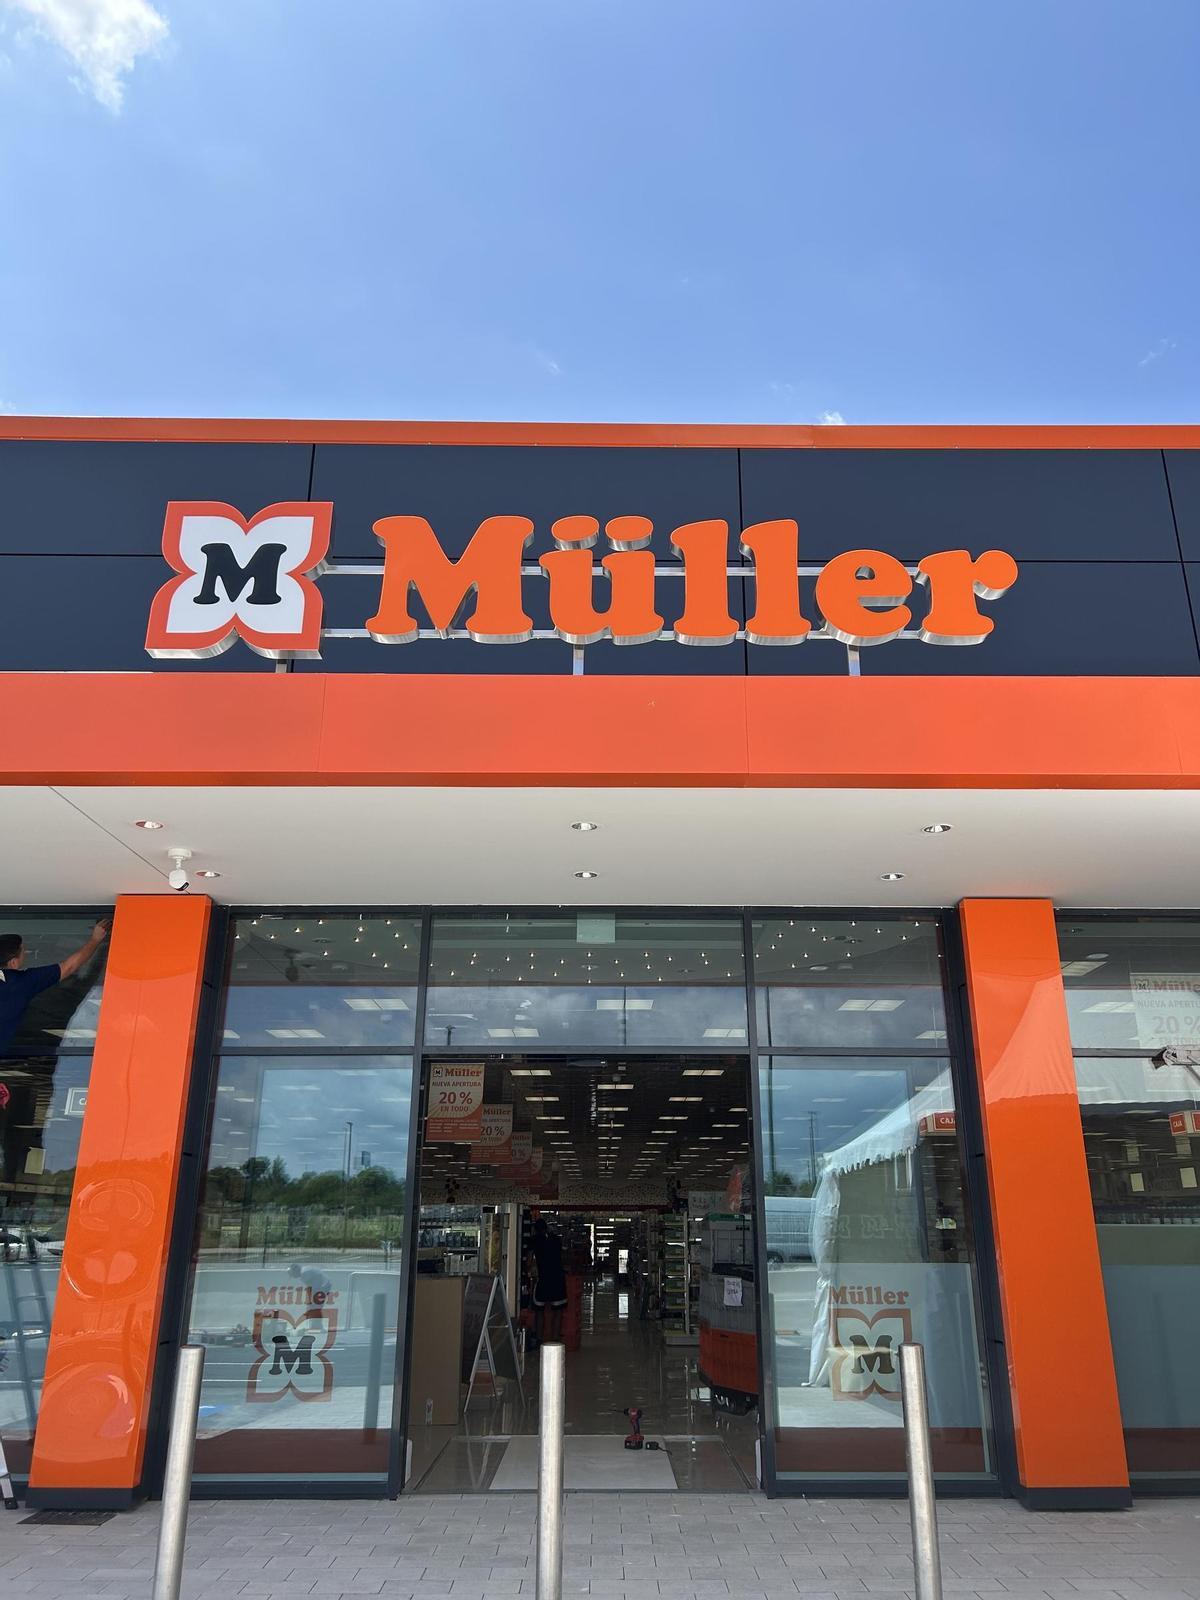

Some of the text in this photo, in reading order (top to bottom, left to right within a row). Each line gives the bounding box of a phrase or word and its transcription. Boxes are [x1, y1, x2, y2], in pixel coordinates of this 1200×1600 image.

[192, 515, 1019, 646] M Müller
[1137, 1000, 1167, 1009] NUEVA
[1153, 1016, 1179, 1034] 20
[444, 1068, 482, 1077] Müller
[439, 1090, 473, 1104] 20 %
[480, 1126, 505, 1136] 20 %
[255, 1286, 339, 1305] Müller
[828, 1286, 909, 1305] Müller
[268, 1335, 316, 1376] M
[849, 1334, 896, 1375] M
